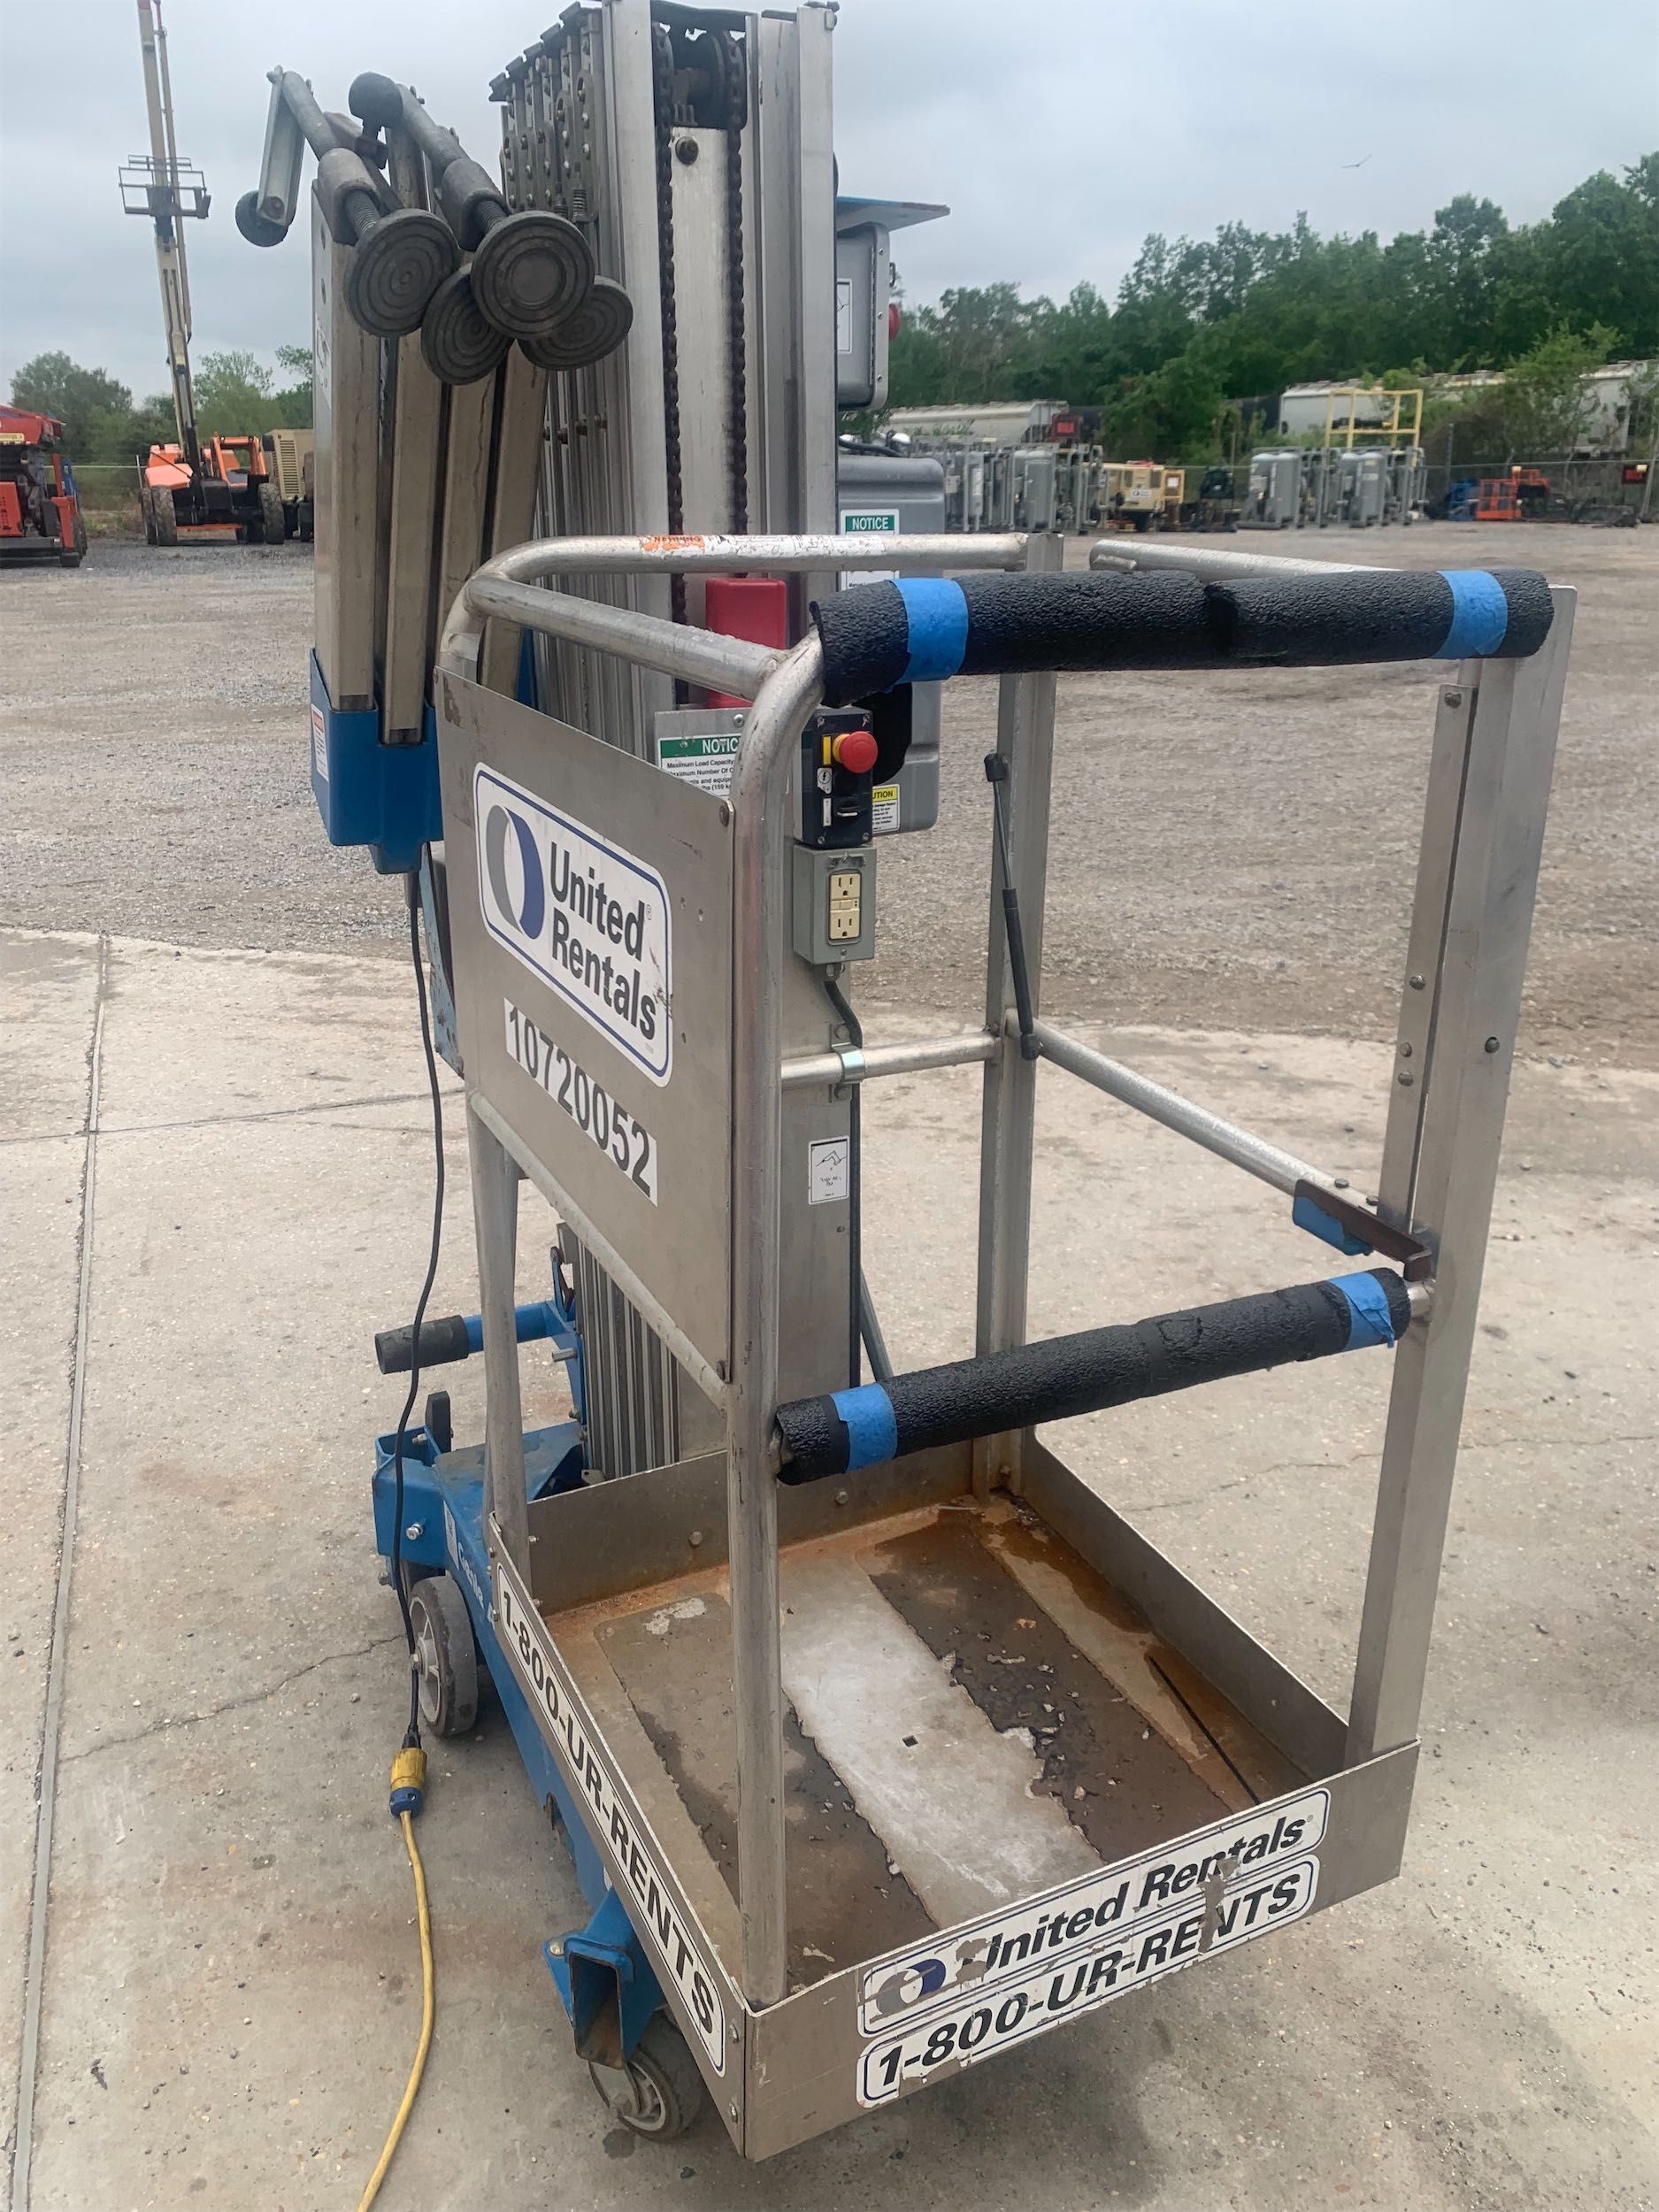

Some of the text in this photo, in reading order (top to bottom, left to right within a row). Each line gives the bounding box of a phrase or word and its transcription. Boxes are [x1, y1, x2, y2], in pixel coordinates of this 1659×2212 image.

[852, 517, 889, 531] NOTICE
[703, 736, 741, 754] NOTIC
[872, 790, 894, 799] UTION
[550, 841, 645, 962] United
[552, 907, 656, 1041] Rentals
[510, 1006, 651, 1199] 10720052
[503, 1591, 714, 2034] 1-800-UR-RENTS
[1139, 1816, 1306, 1909] Rentals
[879, 1873, 1301, 2086] 1-800-UR-RENTS
